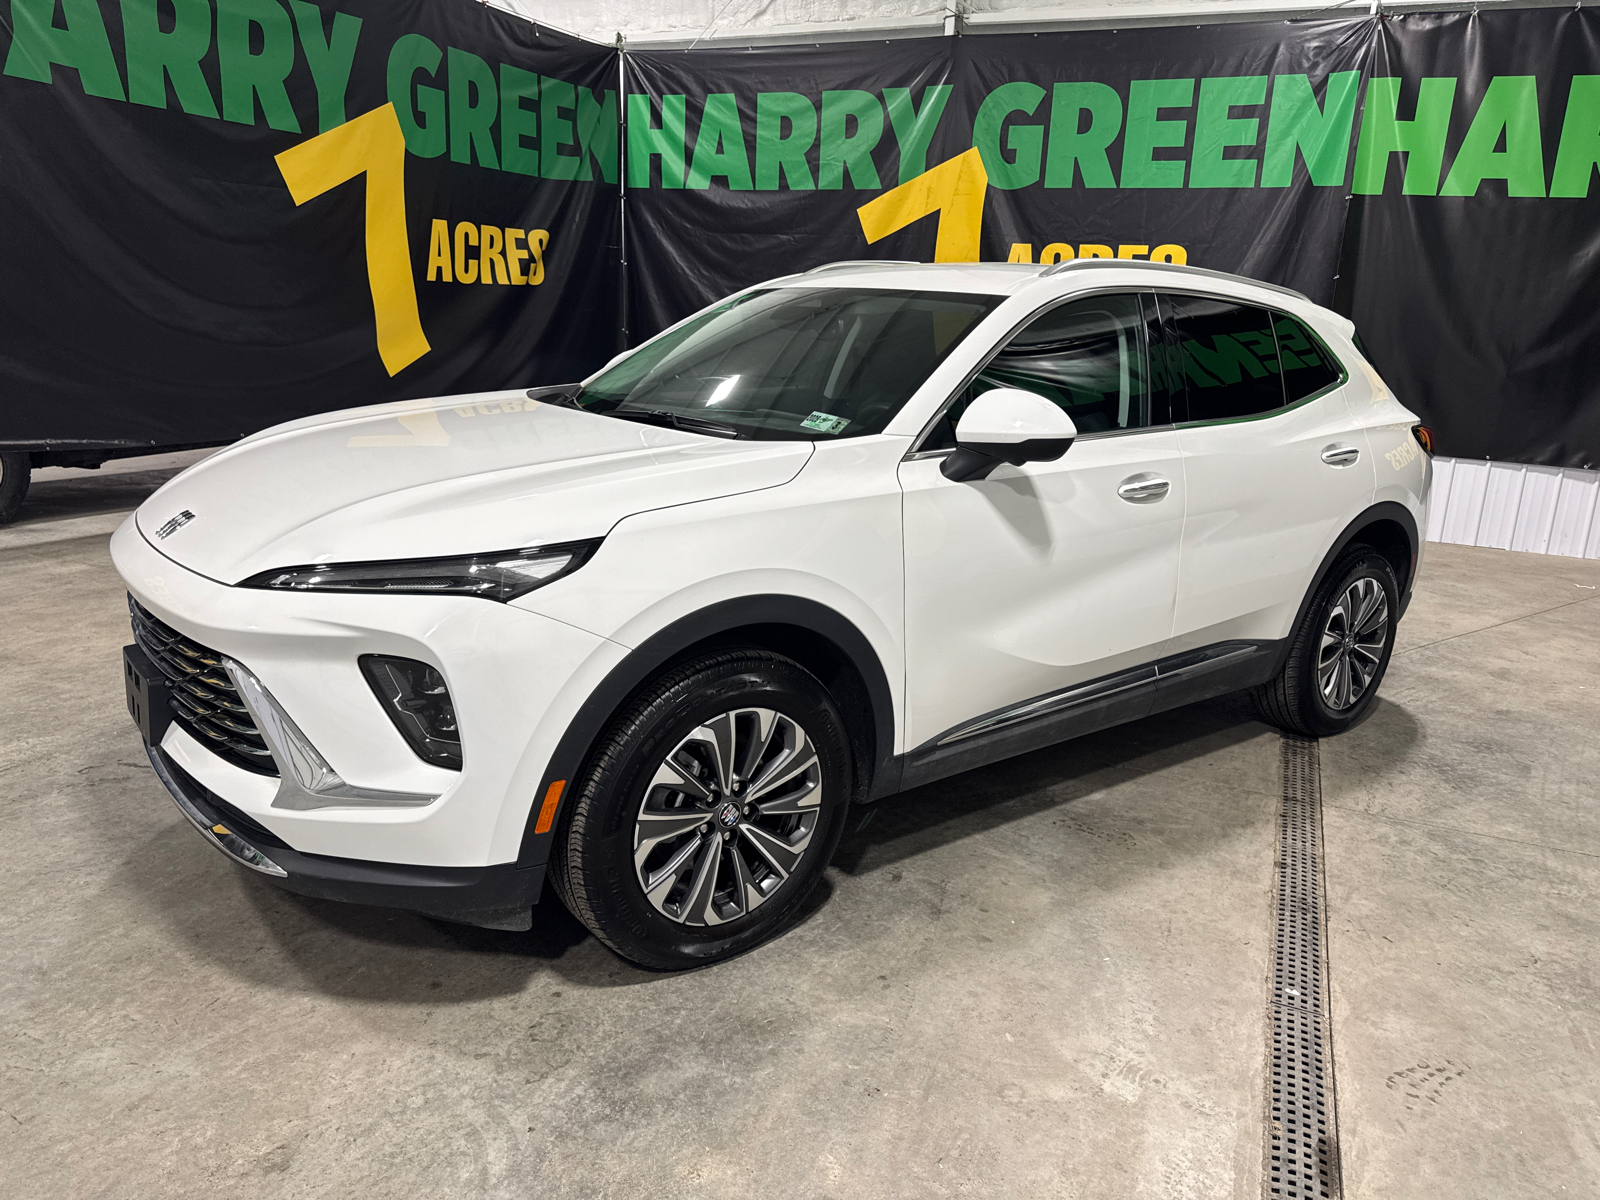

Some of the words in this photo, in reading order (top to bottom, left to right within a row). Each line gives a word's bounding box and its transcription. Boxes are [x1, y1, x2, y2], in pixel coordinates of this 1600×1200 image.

[387, 33, 618, 186] GREEN
[627, 84, 953, 191] HARRY
[972, 70, 1361, 189] GREEN
[274, 101, 431, 377] 7
[426, 218, 550, 287] ACRES
